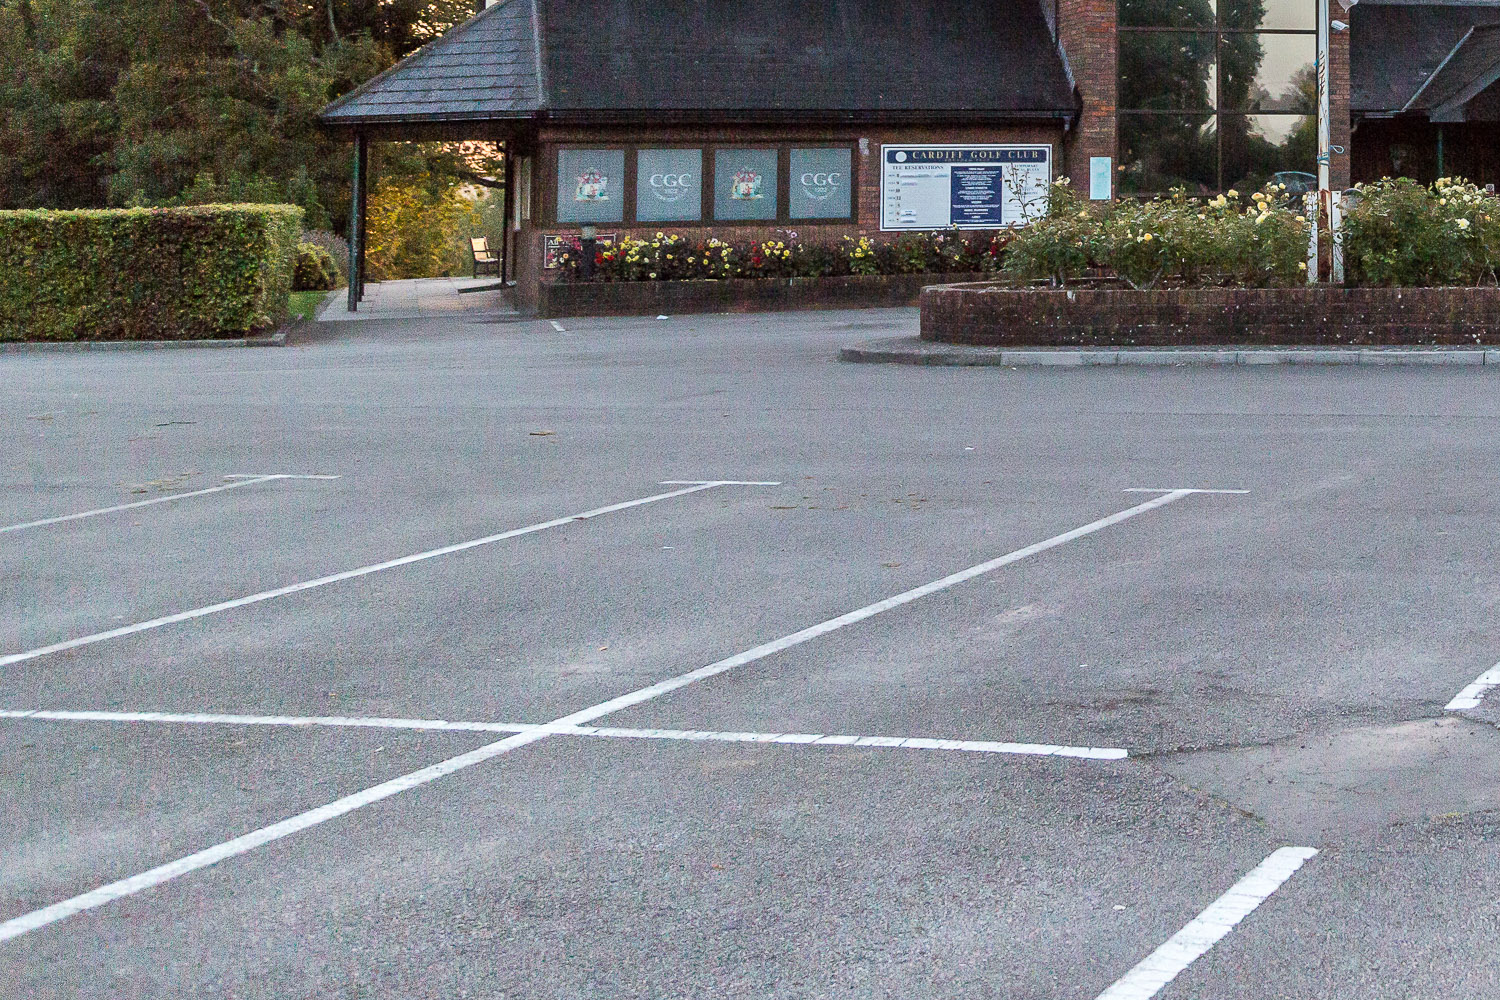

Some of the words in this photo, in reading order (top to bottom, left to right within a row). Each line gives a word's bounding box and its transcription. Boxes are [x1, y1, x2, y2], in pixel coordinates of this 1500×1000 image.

[912, 151, 963, 159] CARDIFF
[650, 173, 692, 187] CGC
[800, 172, 840, 186] CGC
